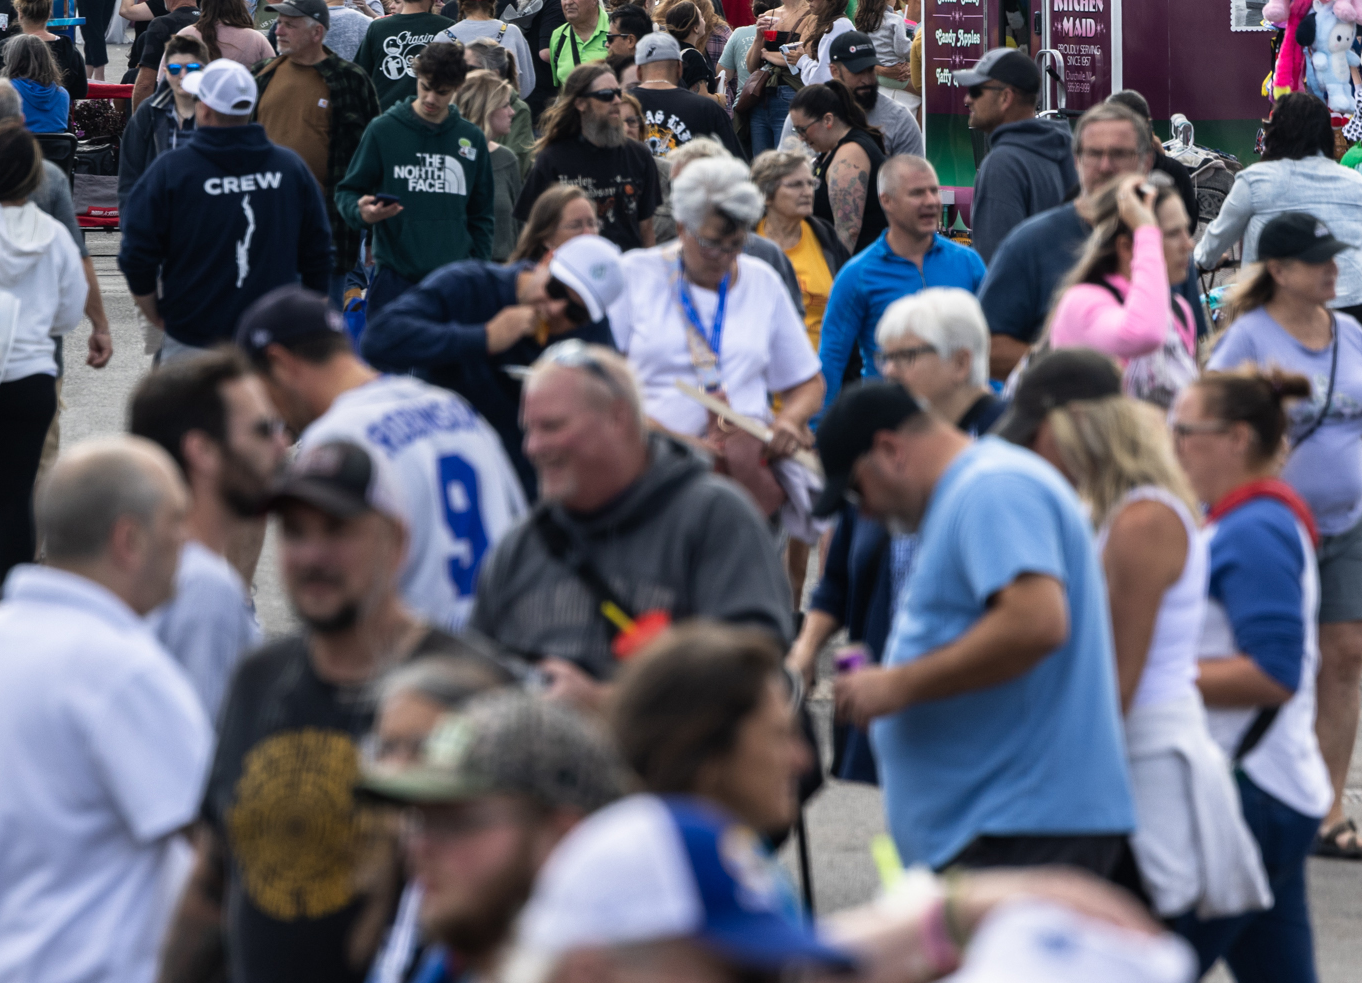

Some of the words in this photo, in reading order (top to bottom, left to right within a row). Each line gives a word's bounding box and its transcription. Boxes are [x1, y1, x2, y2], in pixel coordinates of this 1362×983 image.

[1062, 17, 1096, 38] MAID
[396, 31, 435, 45] Chasin
[935, 28, 956, 47] Candy
[957, 29, 981, 47] Apples
[1057, 44, 1079, 54] PROUDLY
[1079, 44, 1101, 54] SERVING
[1066, 56, 1081, 65] SINCE
[935, 68, 952, 86] Taffy
[417, 154, 444, 168] THE
[394, 166, 444, 180] NORTH
[203, 172, 283, 196] CREW
[408, 178, 444, 193] FACE
[437, 453, 490, 598] 9
